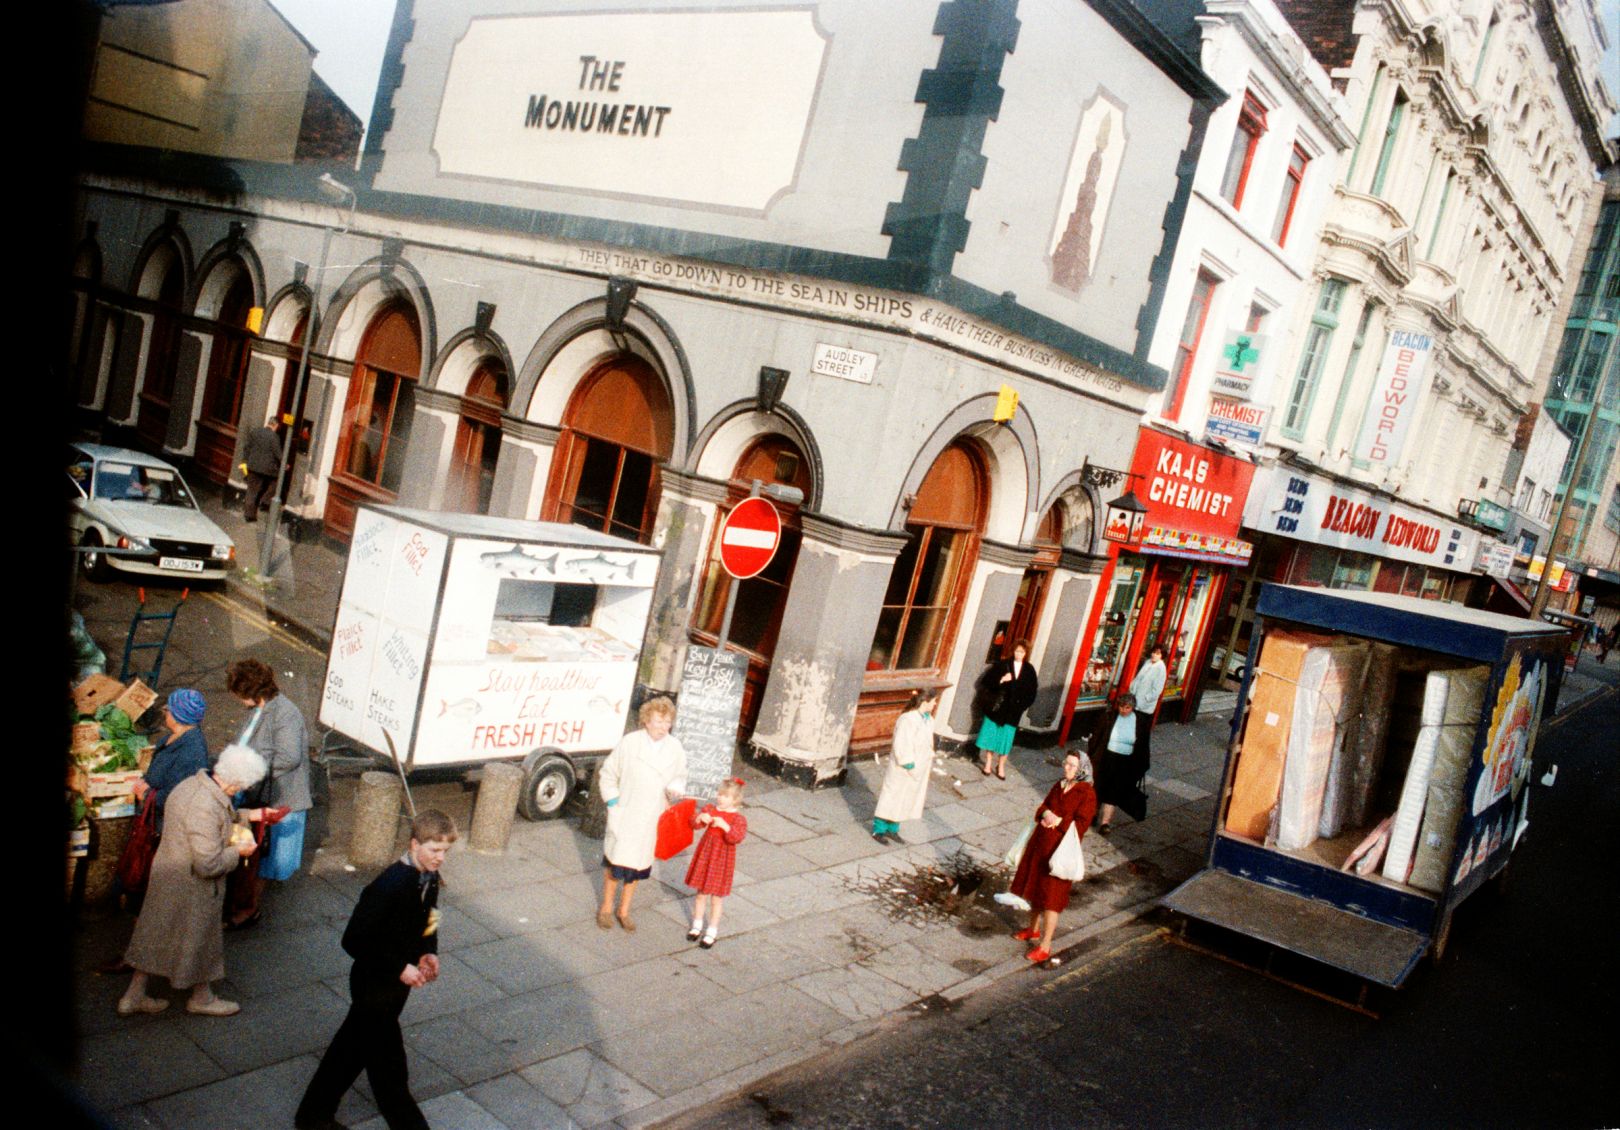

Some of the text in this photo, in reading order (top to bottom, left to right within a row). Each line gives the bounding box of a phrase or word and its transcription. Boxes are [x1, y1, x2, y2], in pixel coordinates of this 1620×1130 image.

[578, 55, 626, 92] THE
[524, 94, 671, 138] MONUMENT
[579, 248, 611, 265] THEY
[614, 254, 649, 271] THAT
[652, 260, 672, 276] GO
[676, 264, 722, 285] DOWN
[727, 272, 747, 288] TO
[752, 277, 784, 296] THE
[790, 283, 823, 303] SEA
[828, 289, 848, 307] IN
[853, 293, 913, 319] SHIPS
[920, 308, 933, 323] &
[935, 311, 966, 335] HAVE
[967, 325, 1004, 348] THEIR
[1004, 339, 1052, 366] BUSINESS
[1051, 357, 1063, 371] IN
[1391, 330, 1432, 352] BEACON
[817, 360, 854, 376] STREET
[826, 350, 865, 365] AUDLEY
[1214, 377, 1250, 392] PHARMACY
[1210, 397, 1265, 425] CHEMIST
[1149, 476, 1232, 517] CHEMIST
[1287, 477, 1310, 497] BEDS
[1283, 497, 1304, 515] BEDS
[1276, 516, 1299, 533] BEDS
[1321, 495, 1381, 540] BEACON
[1382, 514, 1441, 555] BEDWORLD
[478, 668, 526, 704] Stay
[368, 704, 400, 731] STEAKS
[518, 695, 552, 719] Eat
[472, 720, 585, 749] FRESH FISH
